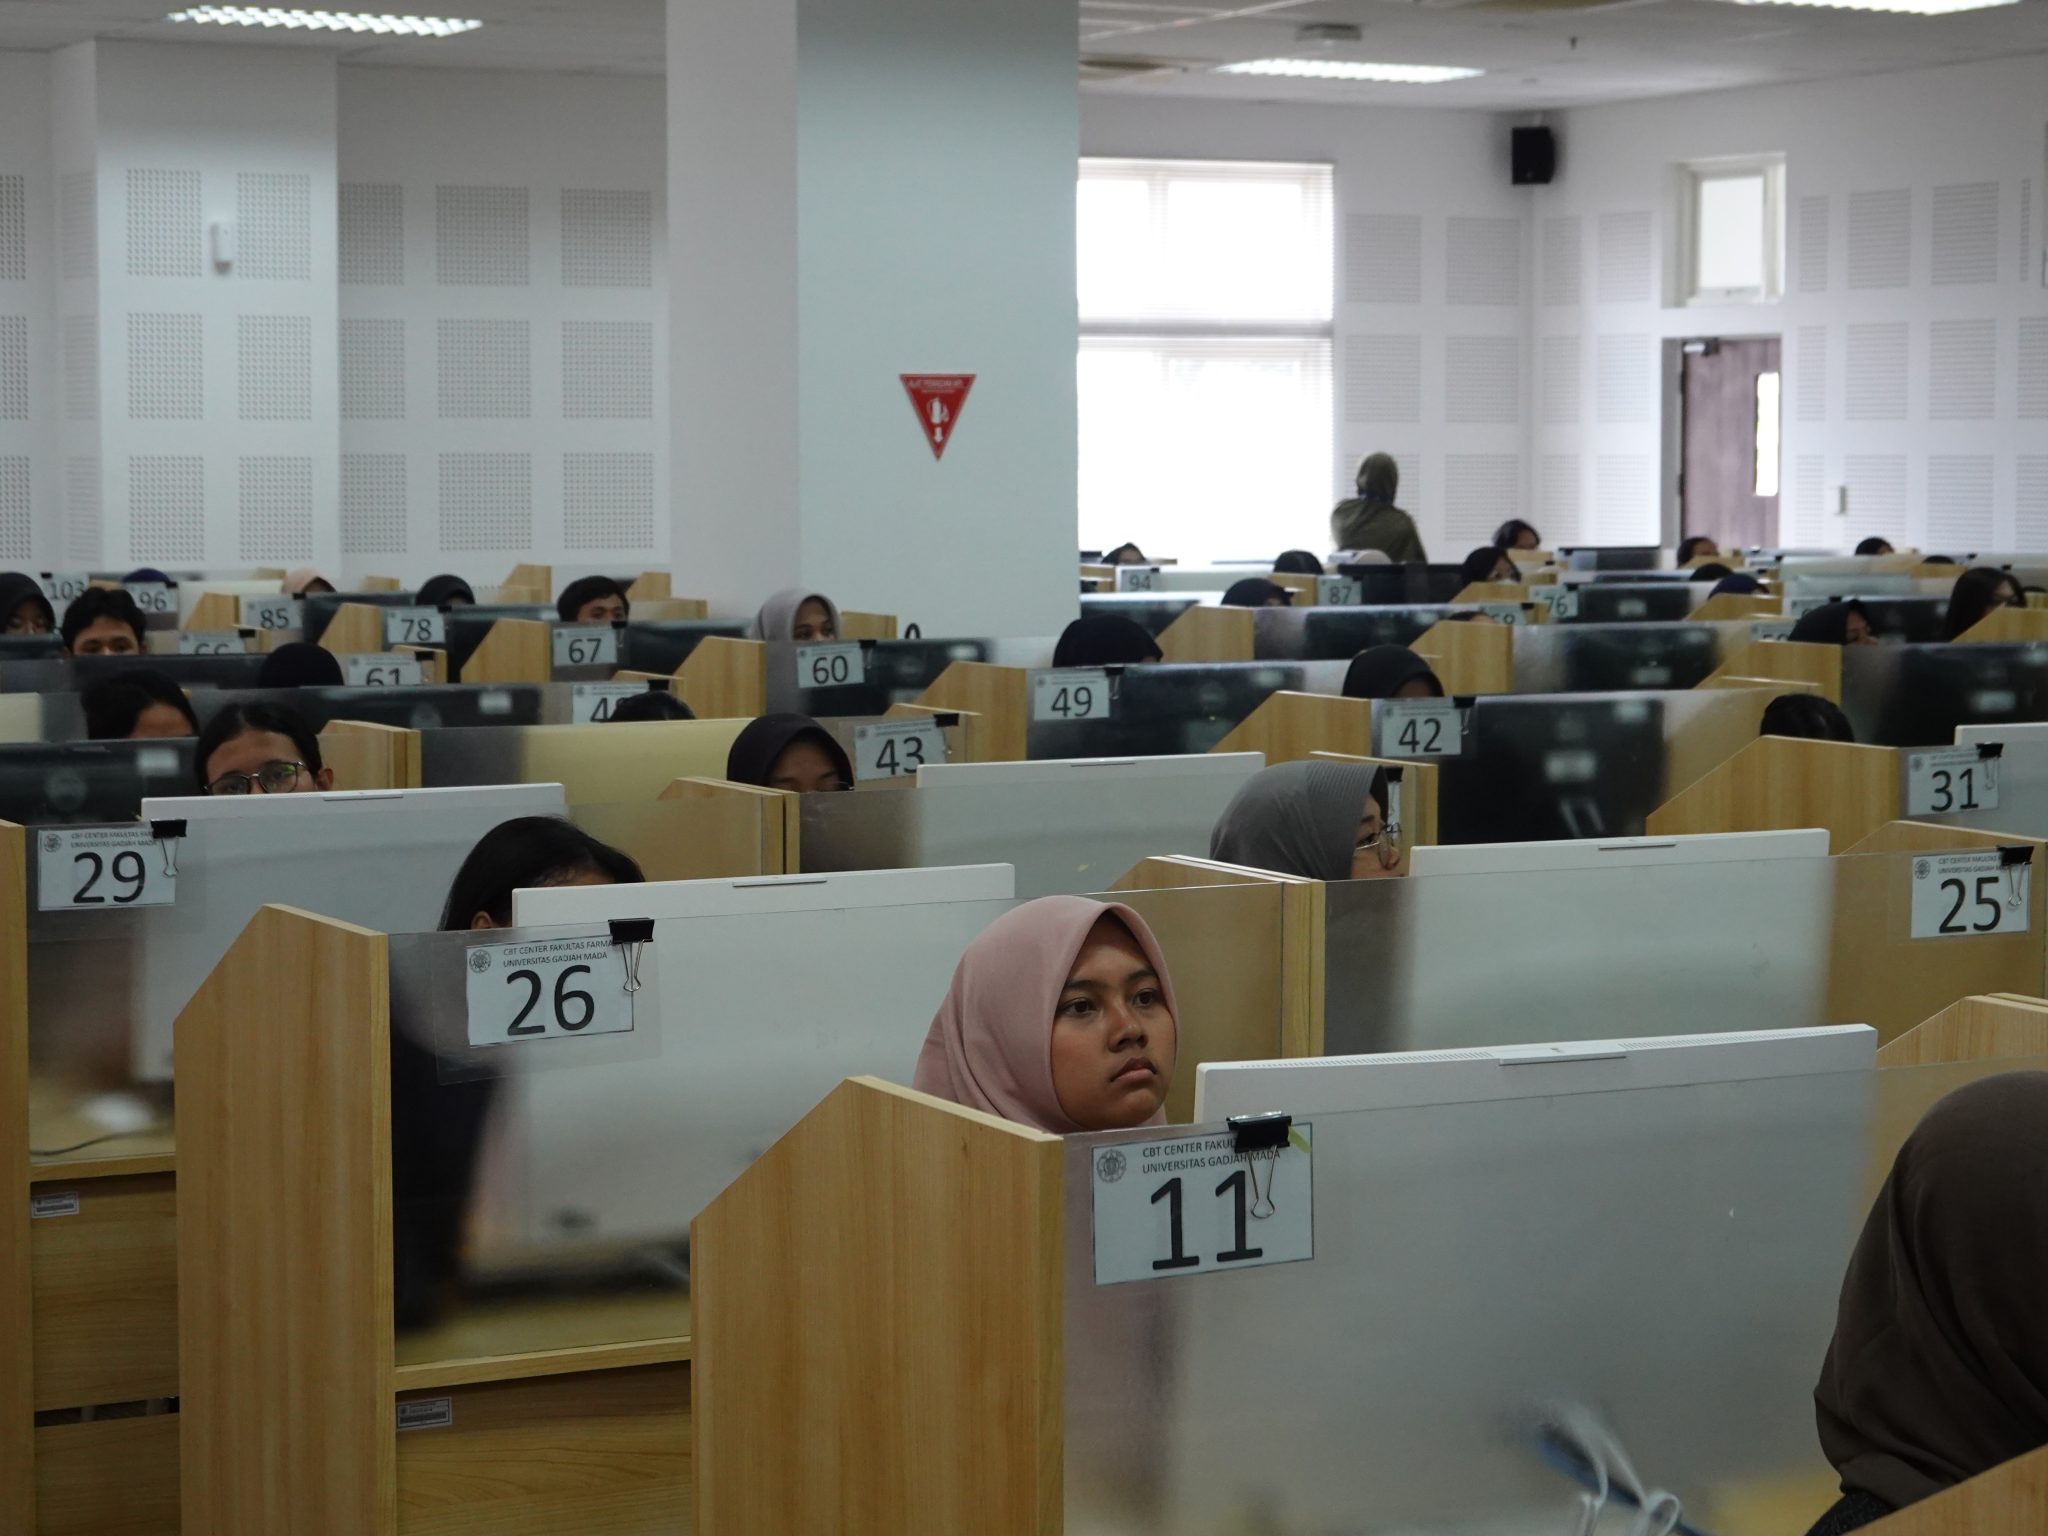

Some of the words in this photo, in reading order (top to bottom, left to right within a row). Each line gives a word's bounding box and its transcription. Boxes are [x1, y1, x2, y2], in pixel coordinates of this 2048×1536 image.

[140, 591, 167, 611] 96
[1329, 586, 1352, 605] 87
[1543, 596, 1567, 616] 76
[260, 608, 289, 630] 85
[400, 618, 432, 642] 78
[568, 638, 602, 664] 67
[812, 655, 849, 685] 60
[1050, 686, 1093, 718] 49
[1398, 717, 1443, 753] 42
[876, 736, 925, 775] 43
[1931, 768, 1980, 812] 31
[73, 850, 146, 904] 29
[1939, 876, 2002, 934] 25
[503, 956, 550, 968] UNIVERSITAS
[552, 953, 582, 963] GADJAH
[584, 951, 608, 960] MADA
[520, 945, 548, 955] CENTER
[550, 941, 585, 952] FAKULTAS
[506, 964, 595, 1036] 26
[1142, 1146, 1162, 1158] CBT
[1164, 1142, 1202, 1156] CENTER
[1142, 1157, 1206, 1174] UNIVERSITAS
[1208, 1153, 1248, 1167] GADJAH
[1251, 1149, 1281, 1162] MADA
[1150, 1170, 1263, 1271] 11
